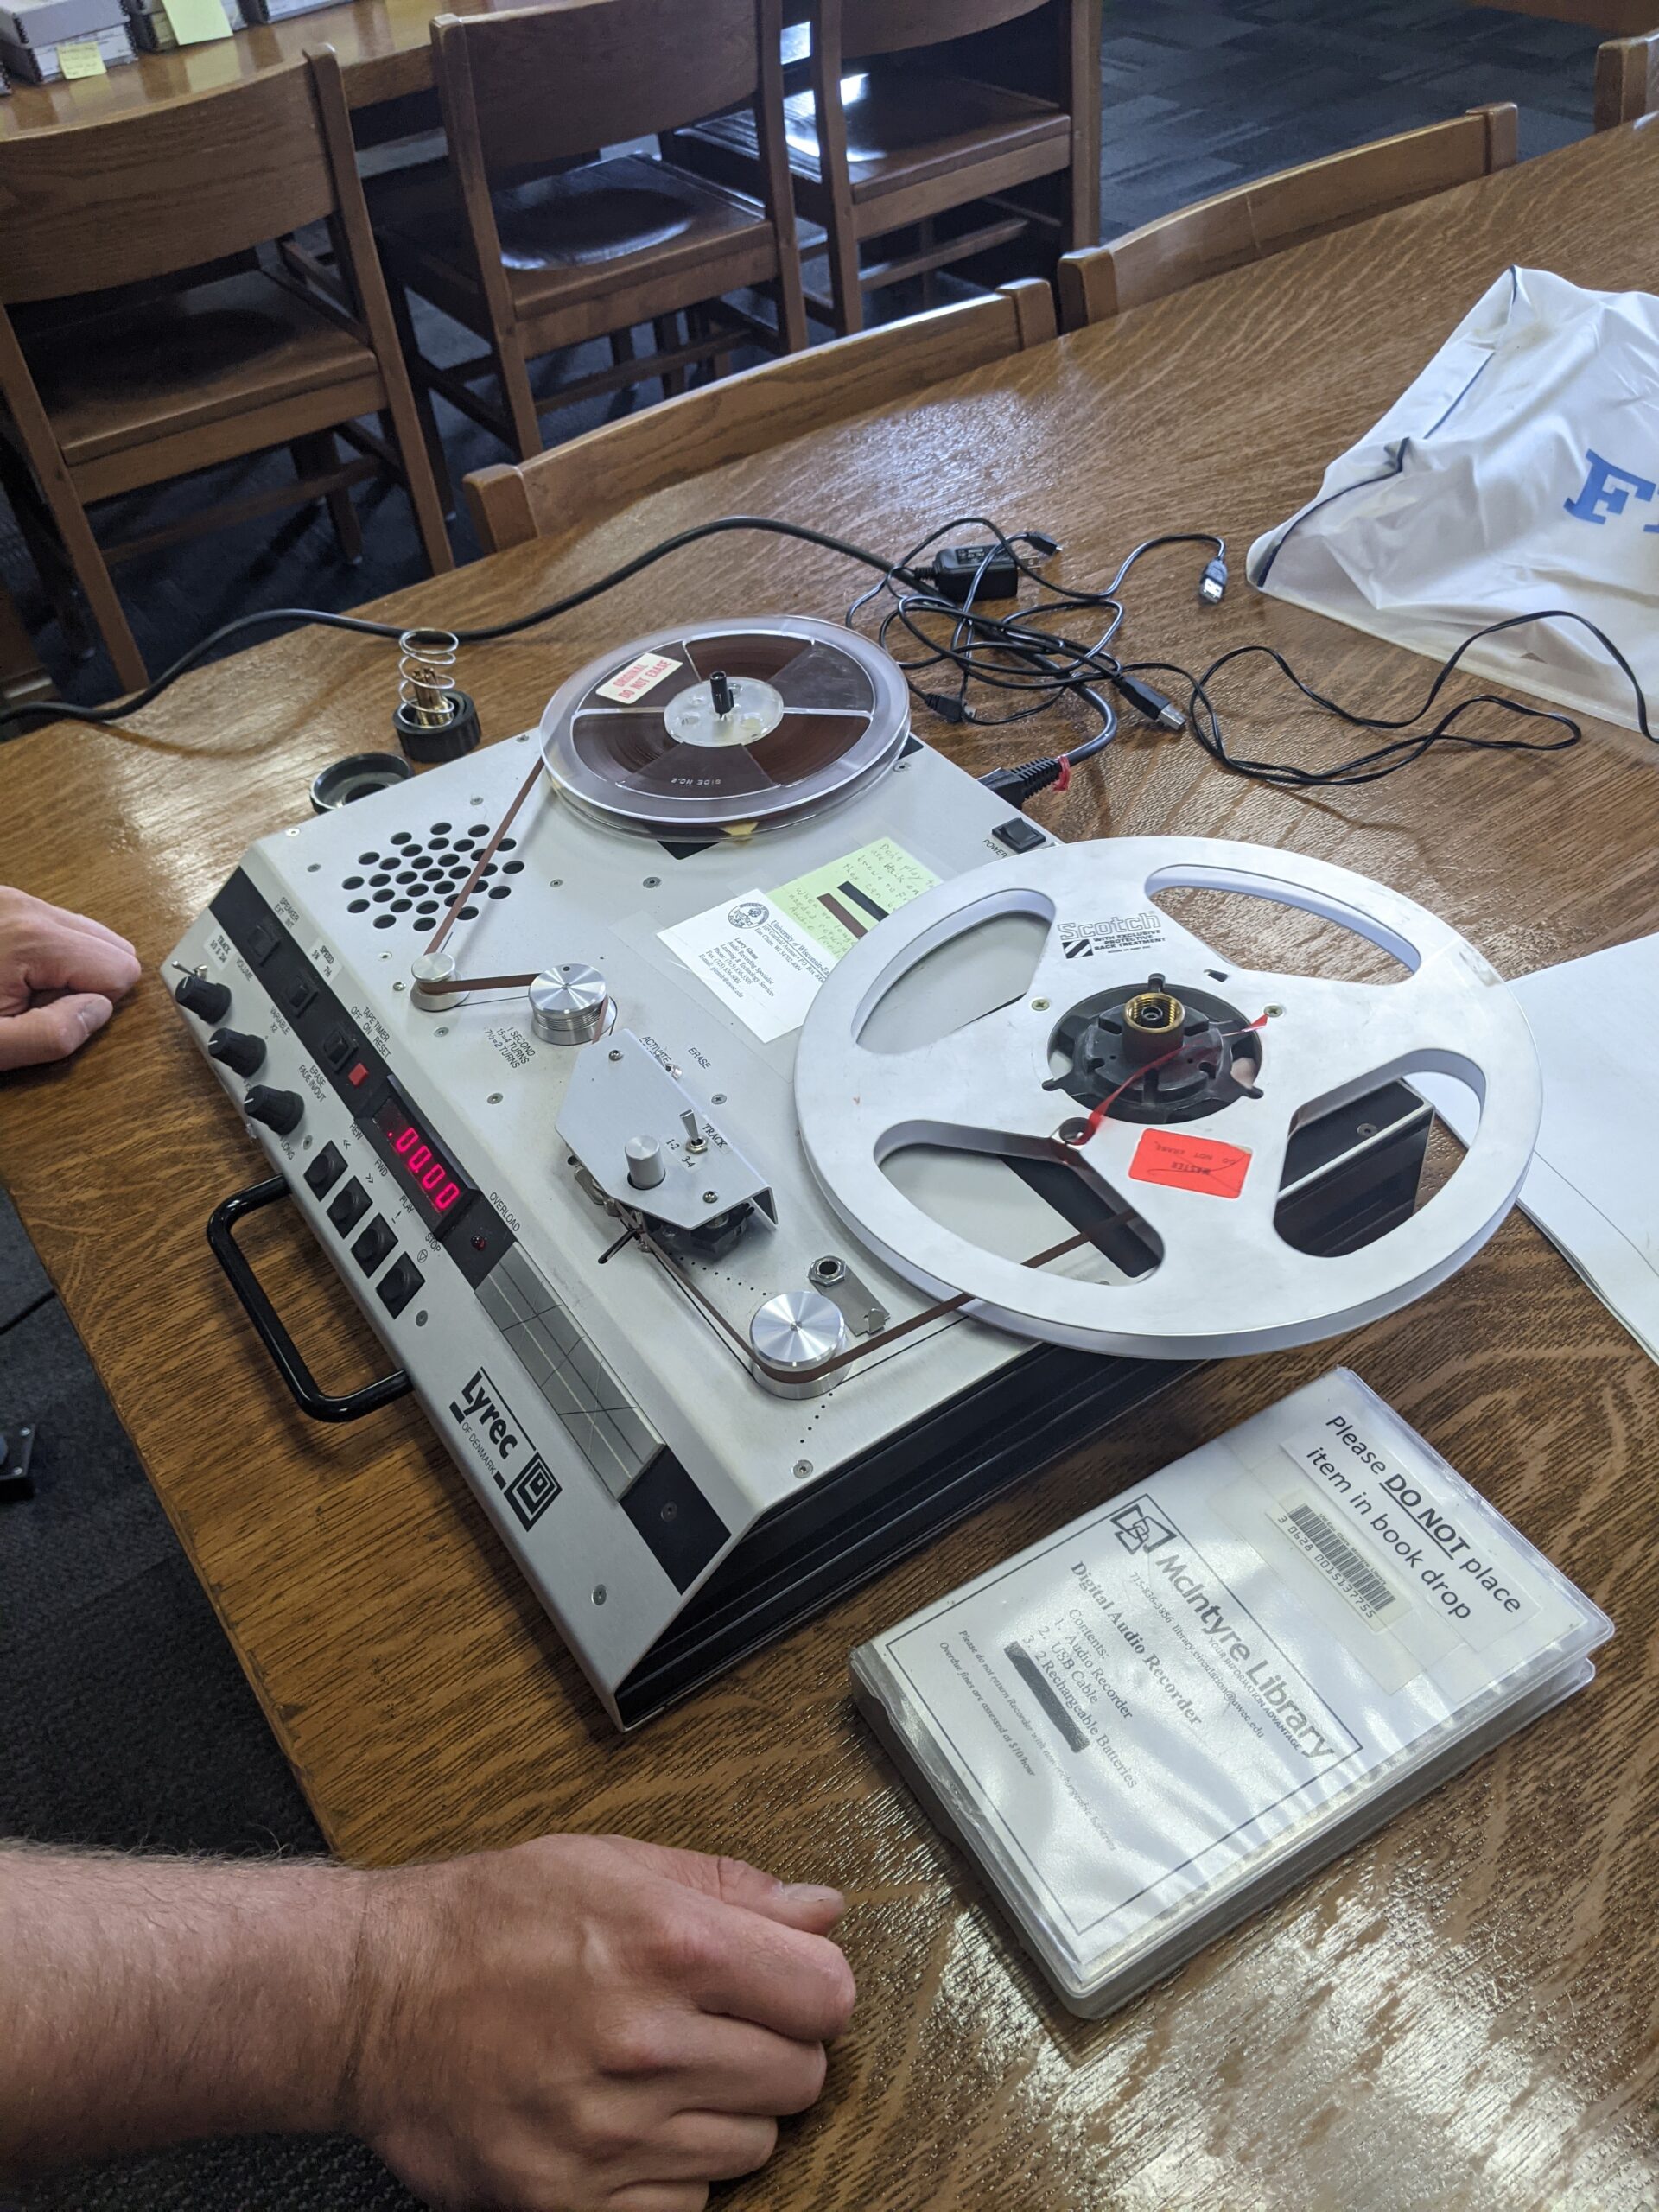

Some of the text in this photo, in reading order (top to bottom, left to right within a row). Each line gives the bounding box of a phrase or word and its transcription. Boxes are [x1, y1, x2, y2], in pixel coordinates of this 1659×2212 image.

[613, 664, 648, 687] ORIGINAL
[619, 660, 671, 698] DO NOT ERASE
[982, 839, 1008, 858] POWER
[274, 904, 295, 929] EXT INT
[280, 897, 299, 922] SPEAKER
[771, 919, 793, 942] University
[1058, 913, 1160, 940] Scotch
[1104, 935, 1154, 944] PROTECTIVE
[1116, 930, 1160, 938] EXCLUSIVE
[320, 945, 334, 964] SPEED
[734, 937, 747, 949] Larry
[1119, 938, 1166, 947] TREATMENT
[237, 959, 253, 981] VOLUME
[720, 944, 736, 959] Learning
[739, 962, 760, 982] Technology
[759, 981, 775, 997] Services
[728, 941, 774, 985] Audio Recording Specialist
[782, 944, 797, 957] Avenue
[805, 966, 815, 975] Box
[270, 1007, 290, 1035] VARIABLE
[351, 1007, 391, 1058] OFF ON RESET
[363, 1007, 390, 1042] TAPE TIMER
[499, 1046, 520, 1068] TURNS
[508, 1042, 529, 1064] TURNS
[511, 1031, 535, 1056] SECOND
[642, 1036, 671, 1063] ACTIVATE
[688, 1047, 711, 1069] ERASE
[299, 1065, 326, 1102] FADE IN/OUT
[309, 1065, 326, 1088] ERASE
[349, 1123, 363, 1140] REW
[702, 1123, 728, 1148] TRACK
[666, 1139, 696, 1168] 1-2 3-4
[374, 1160, 388, 1177] FWD
[400, 1196, 413, 1214] PLAY
[490, 1192, 521, 1232] OVERLOAD
[425, 1233, 441, 1252] STOP
[462, 1371, 518, 1459] Lyrec
[461, 1422, 496, 1475] OF DENMARK
[1277, 1515, 1287, 1523] 3
[1325, 1415, 1521, 1612] Please DO NOT place
[1306, 1446, 1471, 1618] item in book drop
[1336, 1532, 1350, 1546] Claire
[1350, 1547, 1370, 1567] McIntyre
[1370, 1567, 1386, 1586] Library
[1069, 1609, 1109, 1659] Contents:
[1071, 1560, 1202, 1725] Digital Audio Recorder
[1037, 1625, 1097, 1704] 2. USB Cable
[1053, 1618, 1132, 1718] 1. Audio Recorder
[1130, 1572, 1264, 1738] 715-836-3856 library.circulation@uwec.edu
[1155, 1554, 1336, 1758] McIntyre Library
[958, 1630, 978, 1653] Please
[975, 1653, 985, 1663] do
[982, 1663, 994, 1675] not
[990, 1675, 1009, 1699] return
[1007, 1698, 1033, 1731] Recorder
[1208, 1637, 1301, 1751] YOUR INFORMATION ADVANTAGE
[939, 1642, 1035, 1776] Overdue fines are assessed at $10/hour
[1021, 1634, 1137, 1789] 3. 2 Rechargeable Batteries
